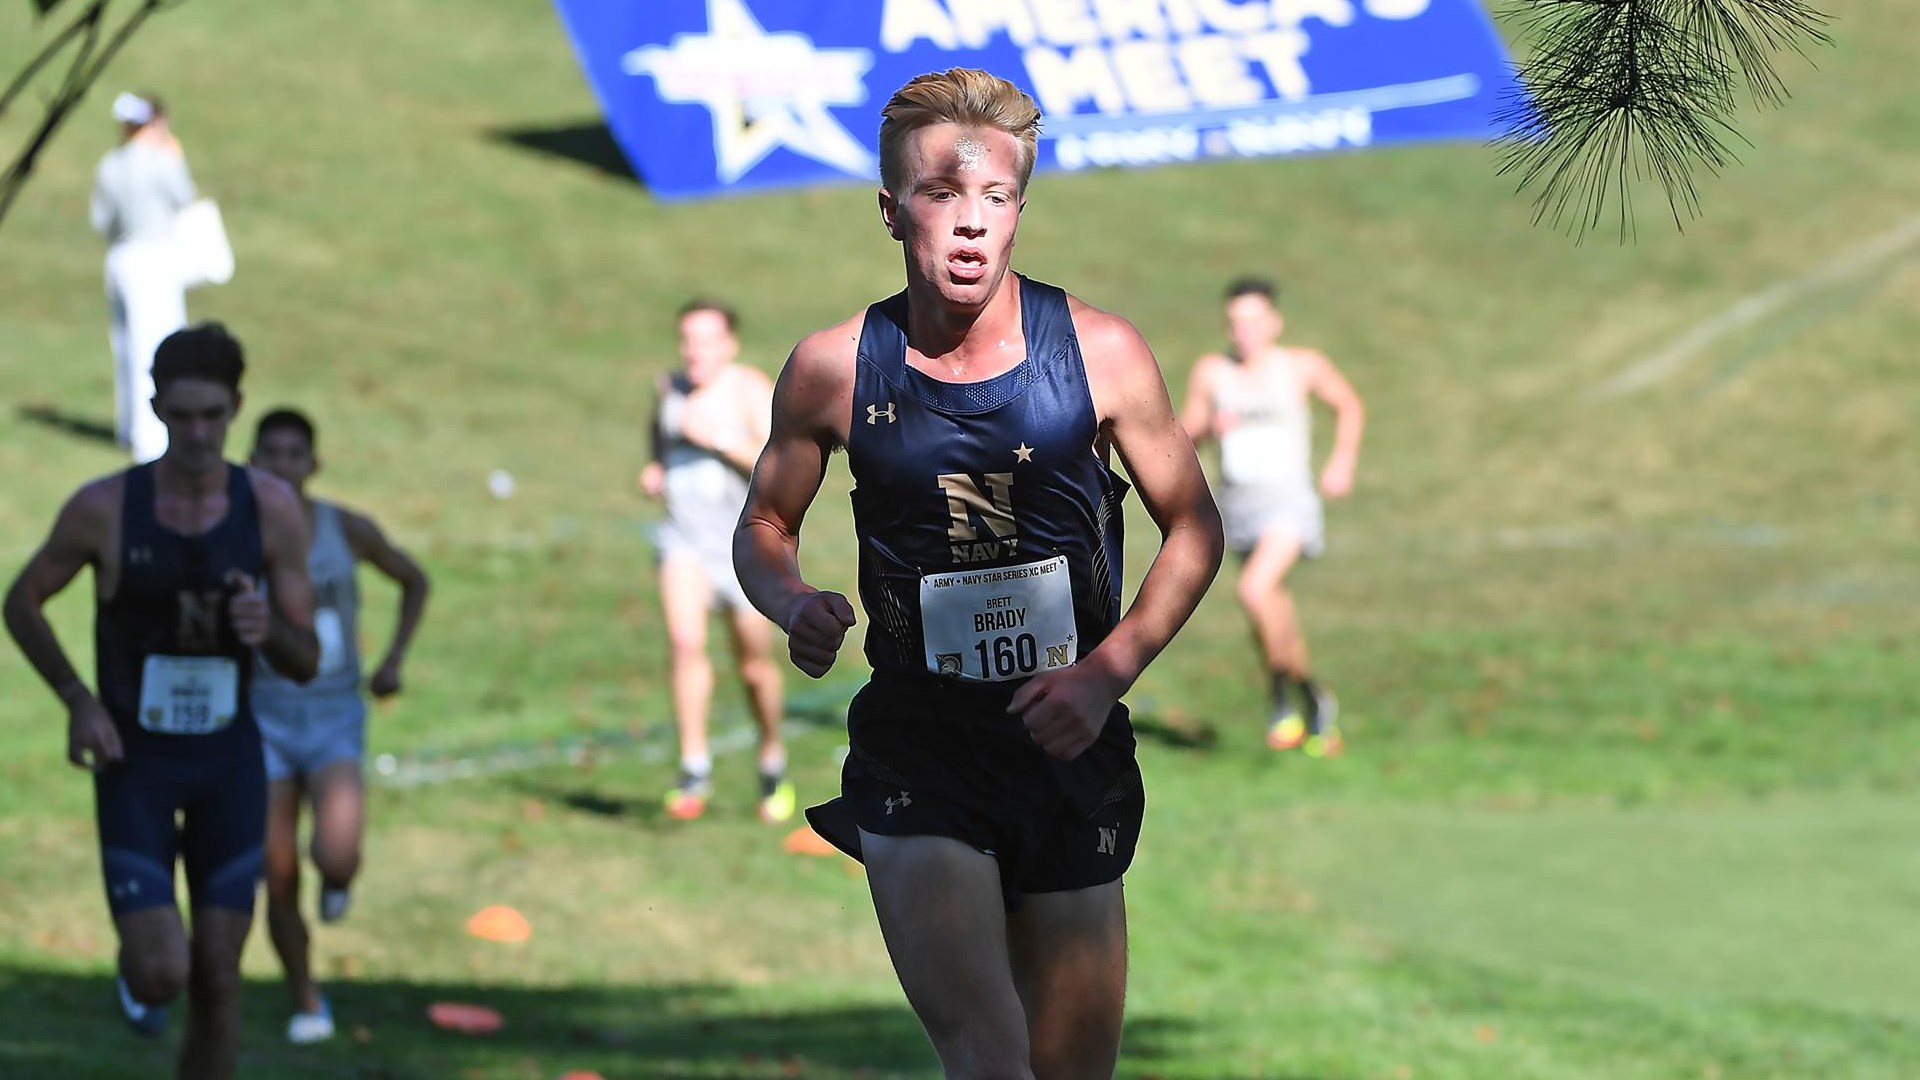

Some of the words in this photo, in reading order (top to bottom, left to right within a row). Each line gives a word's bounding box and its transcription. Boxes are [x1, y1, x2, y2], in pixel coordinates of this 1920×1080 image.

[879, 0, 1433, 53] AMERIC
[1022, 28, 1311, 116] MEET
[936, 472, 1017, 542] N
[950, 538, 1018, 564] NAVY
[933, 578, 954, 588] ARMY
[962, 573, 983, 585] NAVY
[983, 572, 1002, 583] STAR
[1003, 568, 1028, 580] SERIES
[1029, 566, 1039, 577] XC
[1039, 562, 1057, 575] MEET
[986, 596, 1012, 609] BRETT
[973, 608, 1026, 633] BRADY
[975, 633, 1038, 679] 160
[1046, 644, 1069, 668] N
[1096, 826, 1117, 856] N
